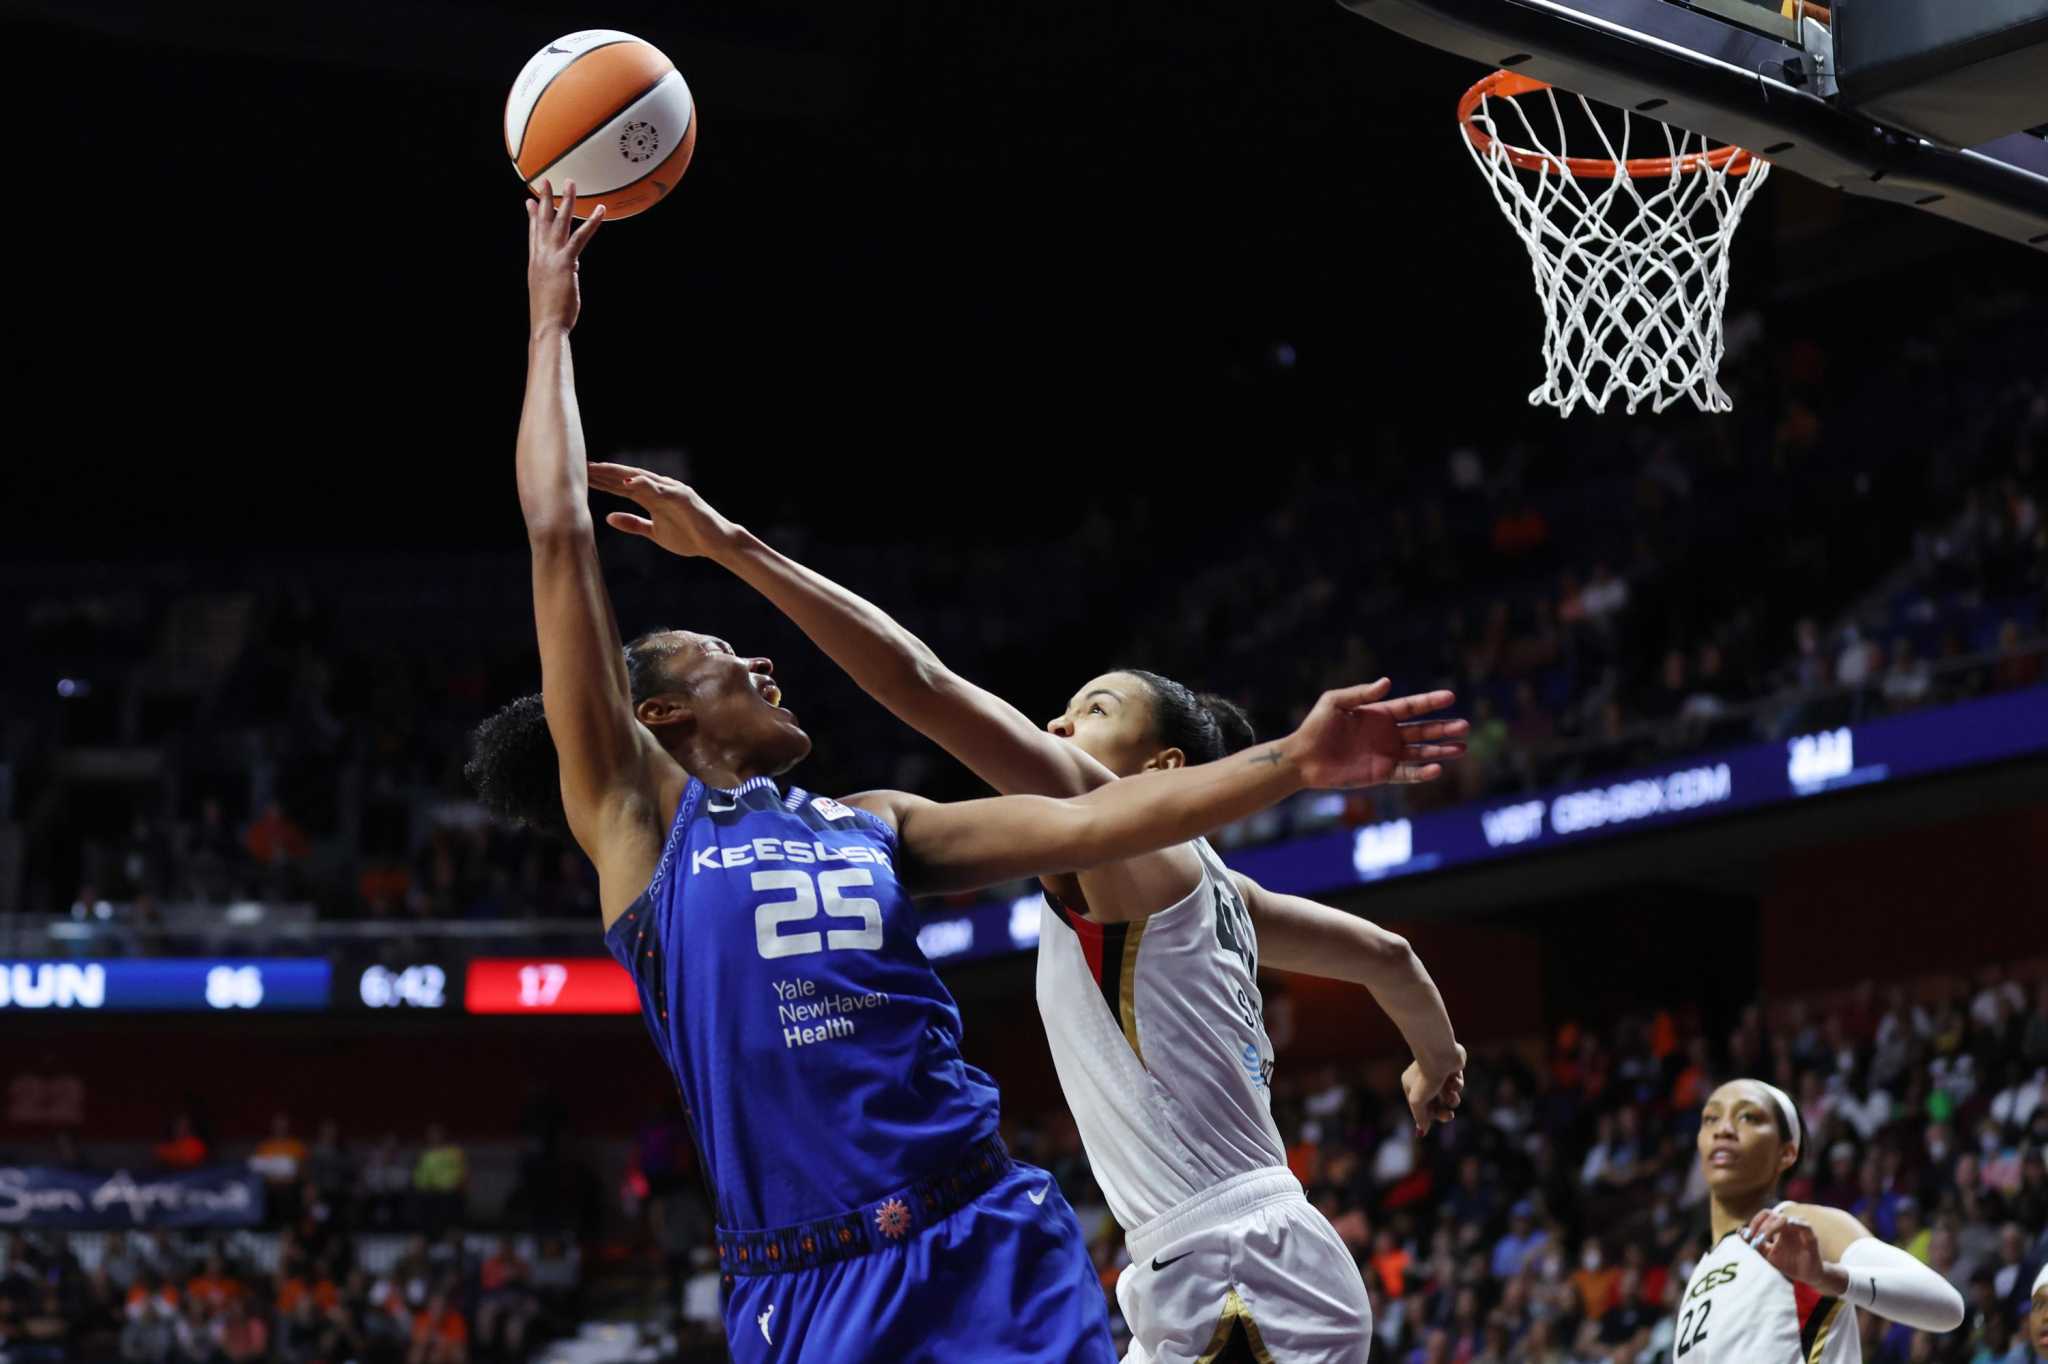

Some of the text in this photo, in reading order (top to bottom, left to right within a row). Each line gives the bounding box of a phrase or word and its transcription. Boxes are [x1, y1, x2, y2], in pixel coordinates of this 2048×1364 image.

[750, 868, 884, 960] 25
[518, 963, 567, 1007] 17
[772, 977, 816, 1001] Yale
[778, 992, 890, 1025] NewHaven
[783, 1016, 855, 1049] Health
[1686, 1261, 1739, 1302] CES
[1677, 1298, 1712, 1359] 22
